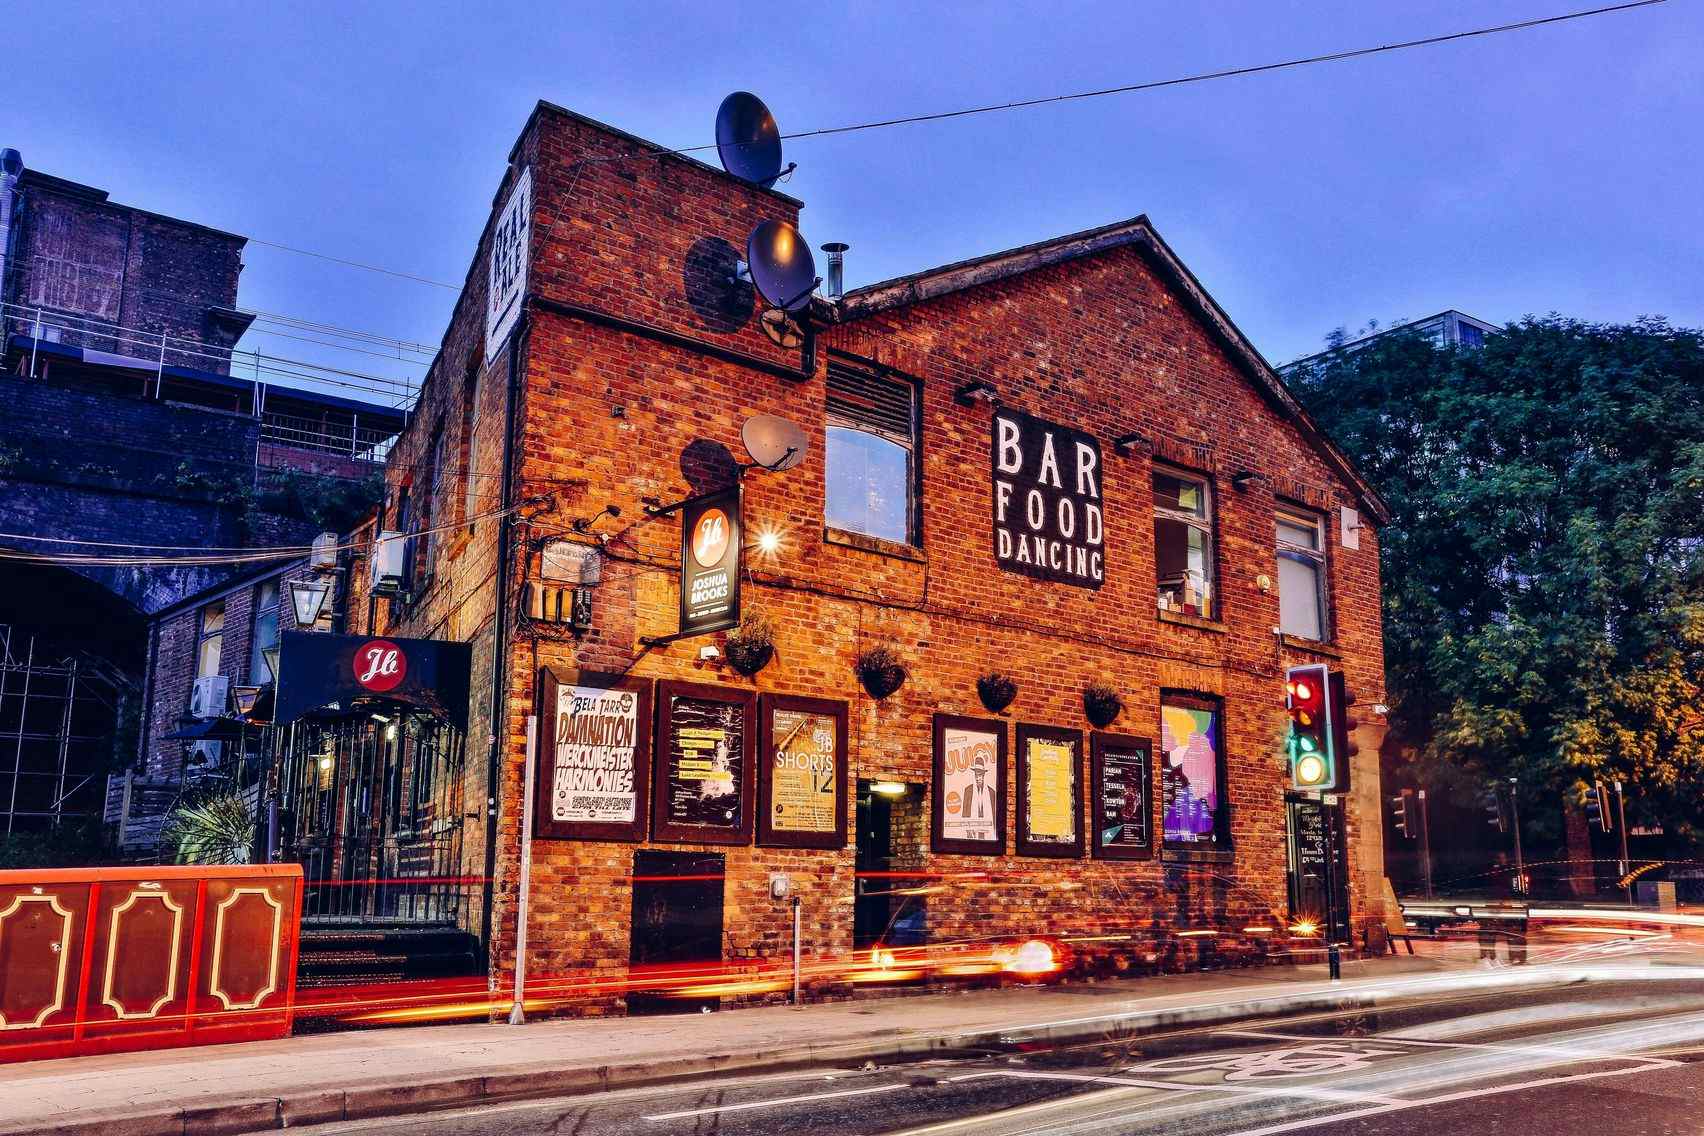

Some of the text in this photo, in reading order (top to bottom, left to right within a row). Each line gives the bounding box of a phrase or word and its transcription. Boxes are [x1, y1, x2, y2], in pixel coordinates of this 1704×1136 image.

[494, 192, 527, 285] REAL
[501, 240, 522, 302] ALE
[996, 416, 1099, 498] BAR
[996, 480, 1103, 545] FOOD
[997, 528, 1103, 581] DANCING
[690, 585, 728, 605] BROOKS
[691, 573, 728, 592] JOSHUA
[600, 699, 621, 715] TARR
[558, 712, 635, 746] DAMNATION
[556, 741, 634, 770] WERCKMEISTER
[776, 751, 833, 771] SHORTS
[555, 767, 634, 792] HARMONIES
[813, 772, 833, 793] 12
